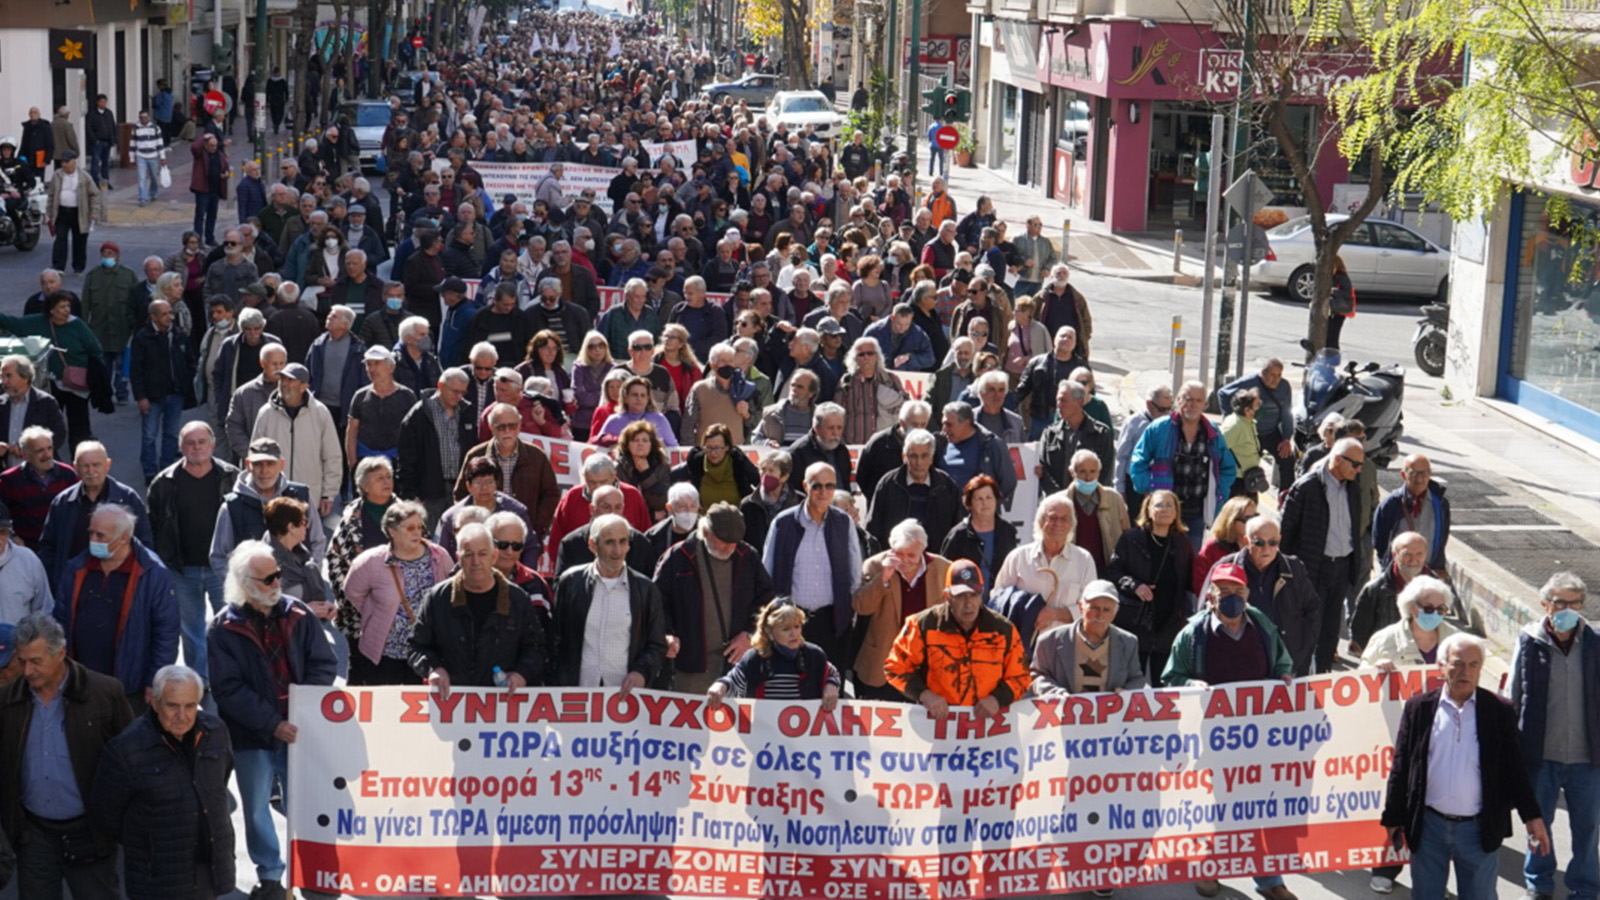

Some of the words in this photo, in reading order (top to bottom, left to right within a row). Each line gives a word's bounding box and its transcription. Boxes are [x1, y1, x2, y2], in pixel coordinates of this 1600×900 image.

[320, 690, 373, 723] ΟΙ
[399, 691, 752, 735] ΣΥΝΤΑΞΙΟΥΧΟΙ
[777, 704, 903, 738] ΟΛΗΣ
[926, 705, 1012, 740] ΤΗΣ
[1031, 690, 1182, 730] ΧΩΡΑΣ
[478, 730, 562, 759] ΤΩΡΑ
[571, 729, 702, 770] αυξήσεις
[711, 744, 747, 768] σε
[756, 742, 822, 779] όλες
[830, 750, 871, 779] τις
[880, 745, 1019, 778] συντάξεις
[1028, 740, 1056, 770] με
[1065, 728, 1200, 761] κατώτερη
[1209, 723, 1259, 751] 650
[1267, 714, 1332, 751] ευρώ
[361, 767, 537, 805] Επαναφορά
[550, 766, 602, 797] 13ης
[628, 769, 681, 797] 14ης
[688, 773, 825, 815] Σύνταξης
[872, 781, 953, 810] ΤΩΡΑ
[963, 779, 1040, 814] μέτρα
[1049, 763, 1214, 803] προστασίας
[1223, 763, 1262, 793] για
[1270, 760, 1316, 787] την
[1324, 744, 1396, 781] ακρίβ
[337, 808, 367, 836] Να
[374, 807, 422, 844] γίνει
[429, 808, 489, 837] ΤΩΡΑ
[496, 806, 562, 843] άμεση
[568, 806, 685, 843] πρόσληψη:
[691, 811, 779, 848] Γιατρών,
[786, 818, 916, 852] Νοσηλευτών
[921, 825, 957, 846] στα
[964, 806, 1078, 843] Νοσοκομεία
[1108, 803, 1136, 830] Να
[1142, 799, 1227, 832] ανοίξουν
[1232, 791, 1278, 822] αυτά
[1284, 796, 1321, 818] που
[1326, 786, 1382, 820] έχουν
[316, 870, 355, 891] ΙΚΑ
[374, 874, 438, 893] ΟΑΕΕ
[457, 873, 581, 893] ΔΗΜΟΣΙΟΥ
[600, 873, 661, 891] ΠΟΣΕ
[667, 875, 727, 893] ΟΑΕΕ
[747, 878, 804, 897] ΕΛΤΑ
[823, 881, 868, 899] ΟΣΕ
[888, 882, 931, 899] ΠΕΣ
[938, 879, 980, 899] ΝΑΤ
[998, 873, 1041, 895] ΠΣΣ
[1045, 863, 1168, 890] ΔΙΚΗΓΟΡΩΝ
[1188, 856, 1257, 878] ΠΟΣΕΑ
[1263, 850, 1329, 873] ΕΤΕΑΠ
[540, 848, 815, 877] ΣΥΝΕΡΓΑΖΟΜΕΝΕΣ
[829, 846, 1070, 878] ΣΥΝΤΑΞΙΟΥΧΙΚΕΣ
[1084, 832, 1256, 865] ΟΡΓΑΝΩΣΕΙΣ
